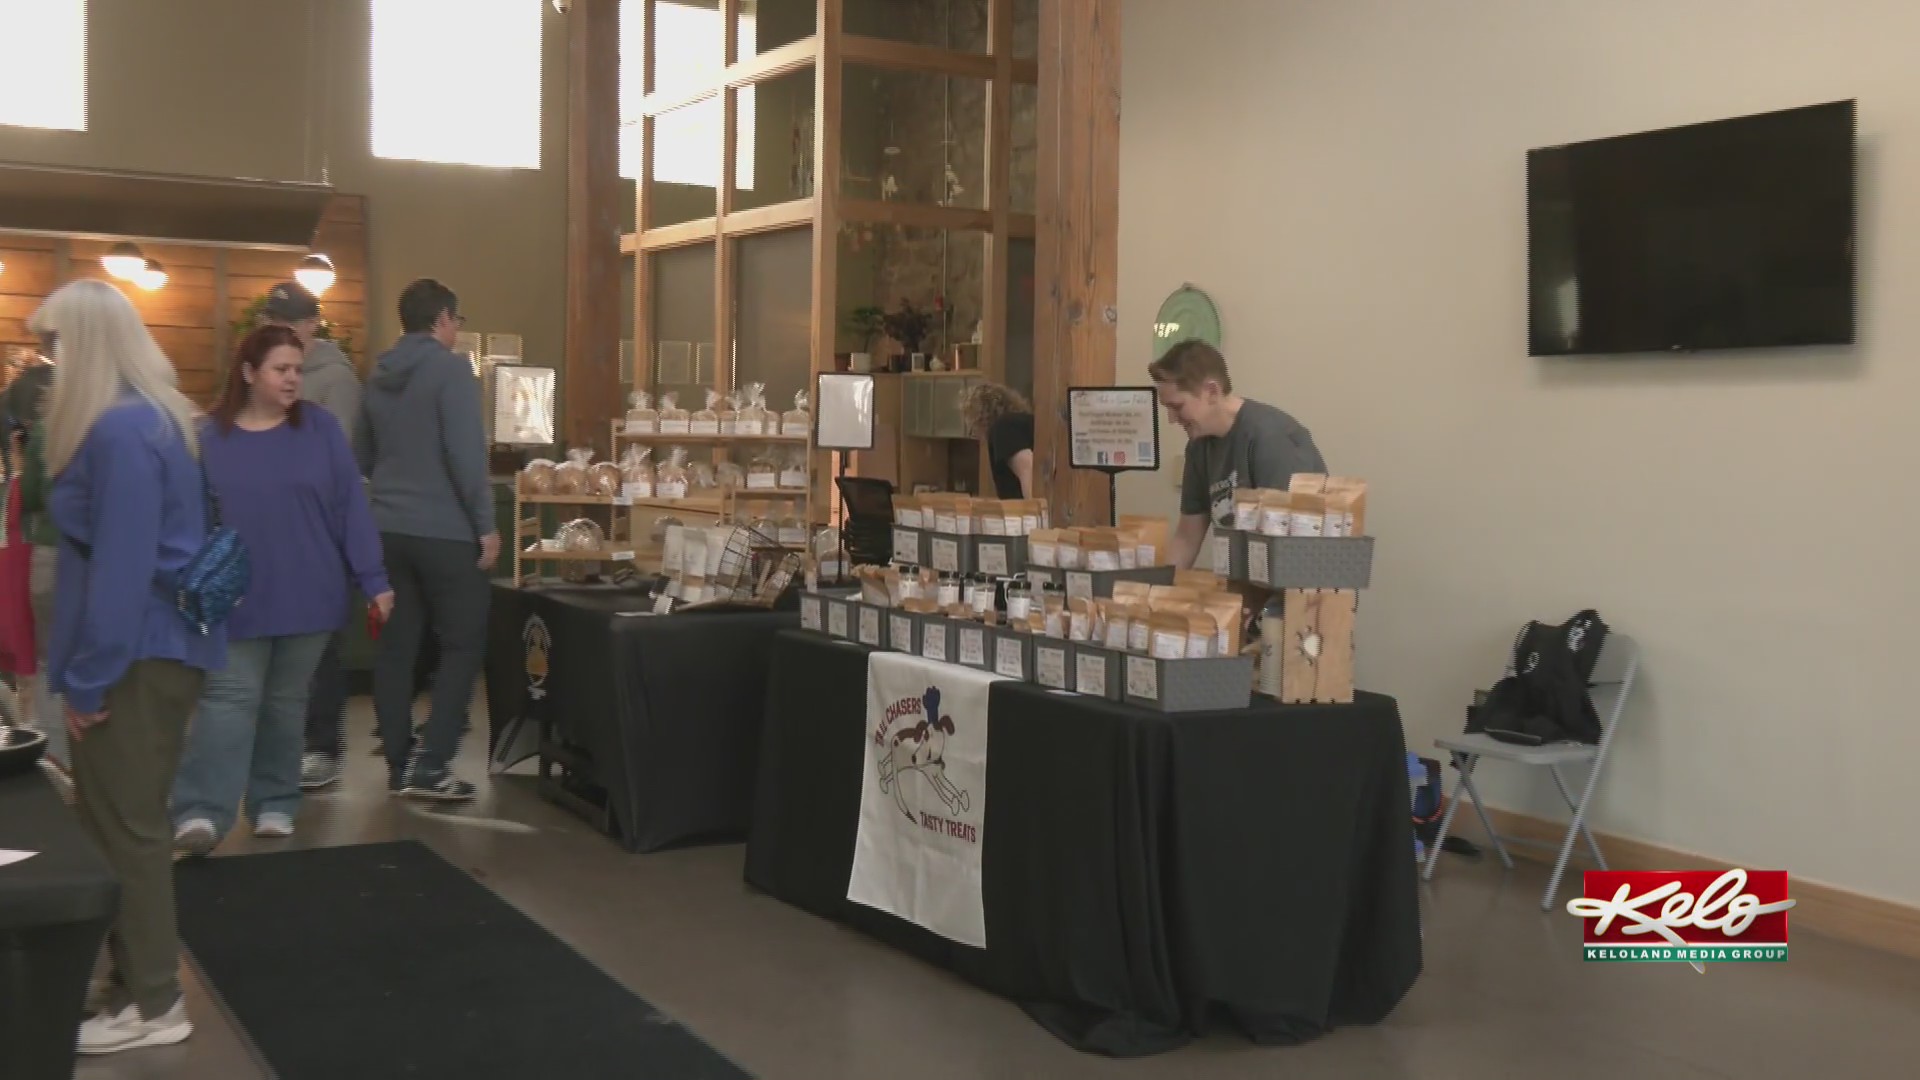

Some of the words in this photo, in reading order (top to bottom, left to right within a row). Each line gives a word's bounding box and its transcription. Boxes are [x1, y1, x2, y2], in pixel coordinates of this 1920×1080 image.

[885, 697, 922, 725] CHASERS
[919, 811, 943, 833] TASTY
[945, 819, 976, 843] TREATS
